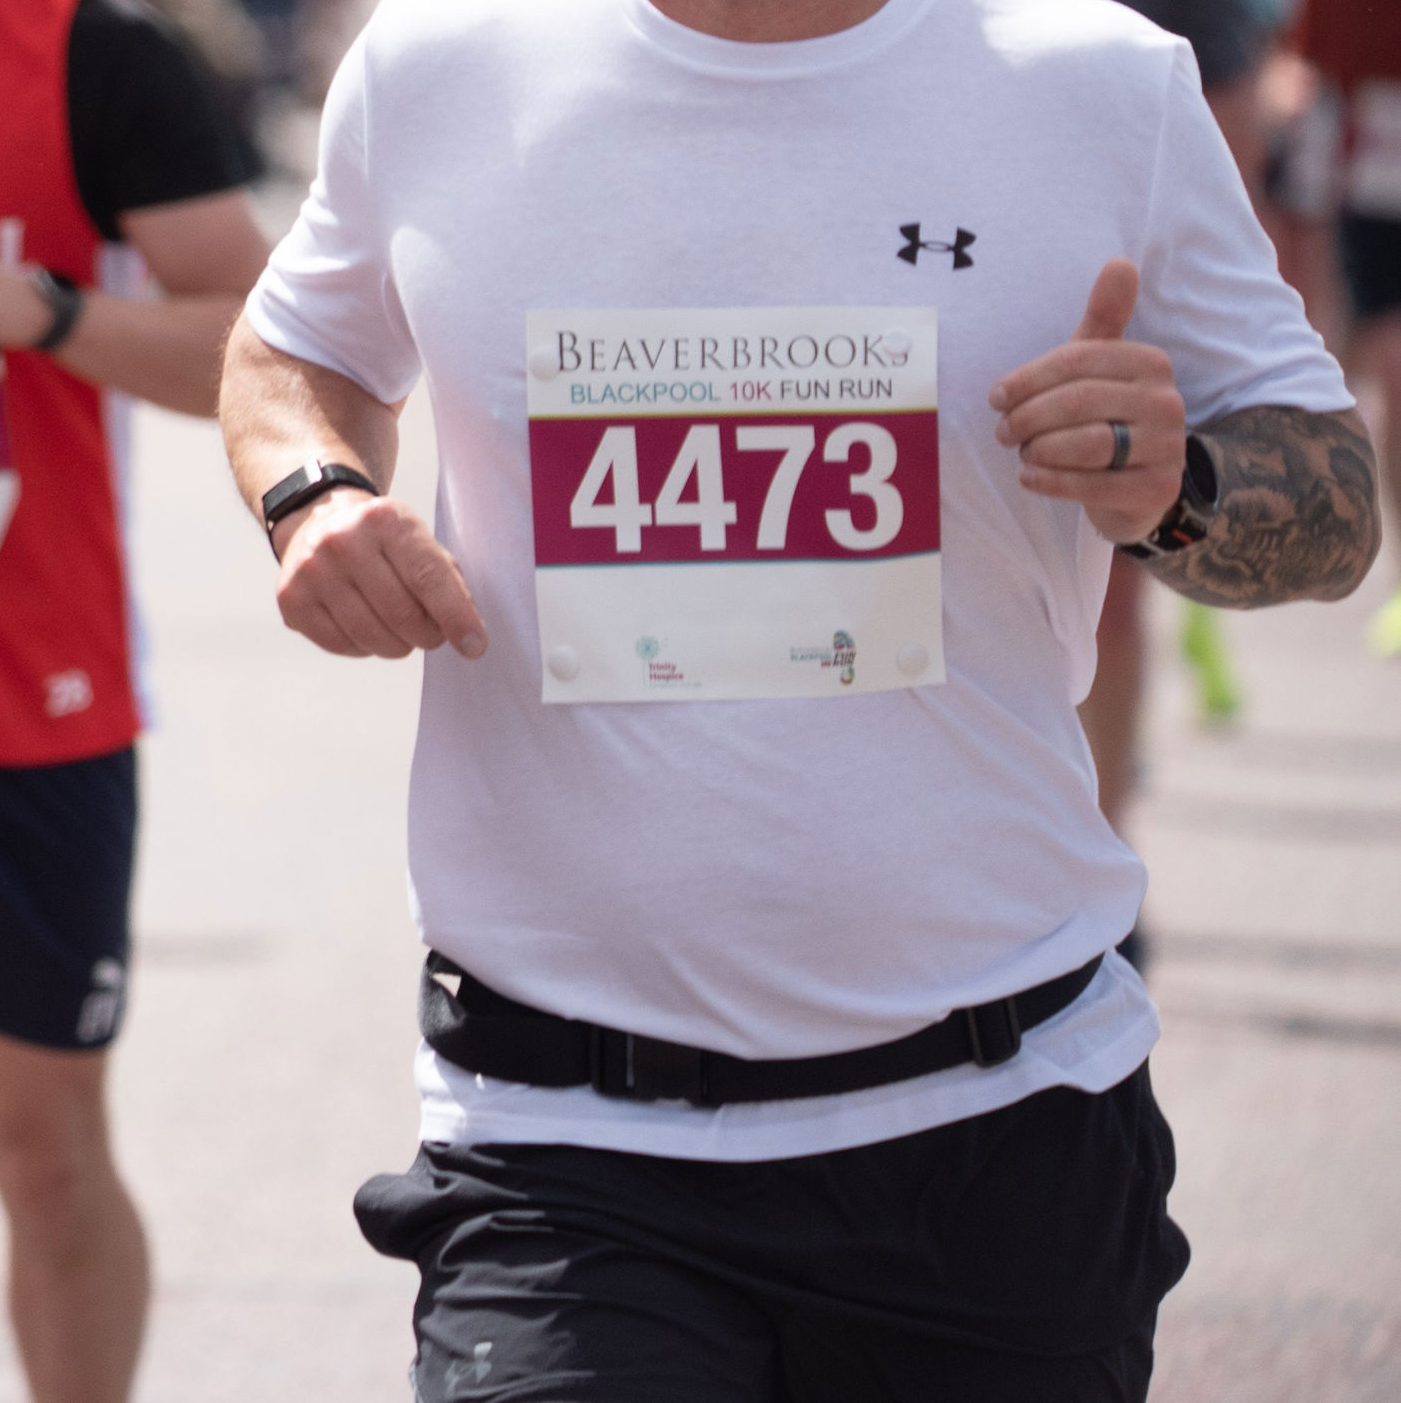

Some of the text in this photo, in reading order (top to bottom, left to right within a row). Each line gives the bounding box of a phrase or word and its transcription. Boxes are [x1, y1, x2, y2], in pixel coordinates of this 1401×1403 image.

[570, 377, 893, 405] BLACKPOOL 10K FUN RUN
[569, 422, 904, 553] 4473
